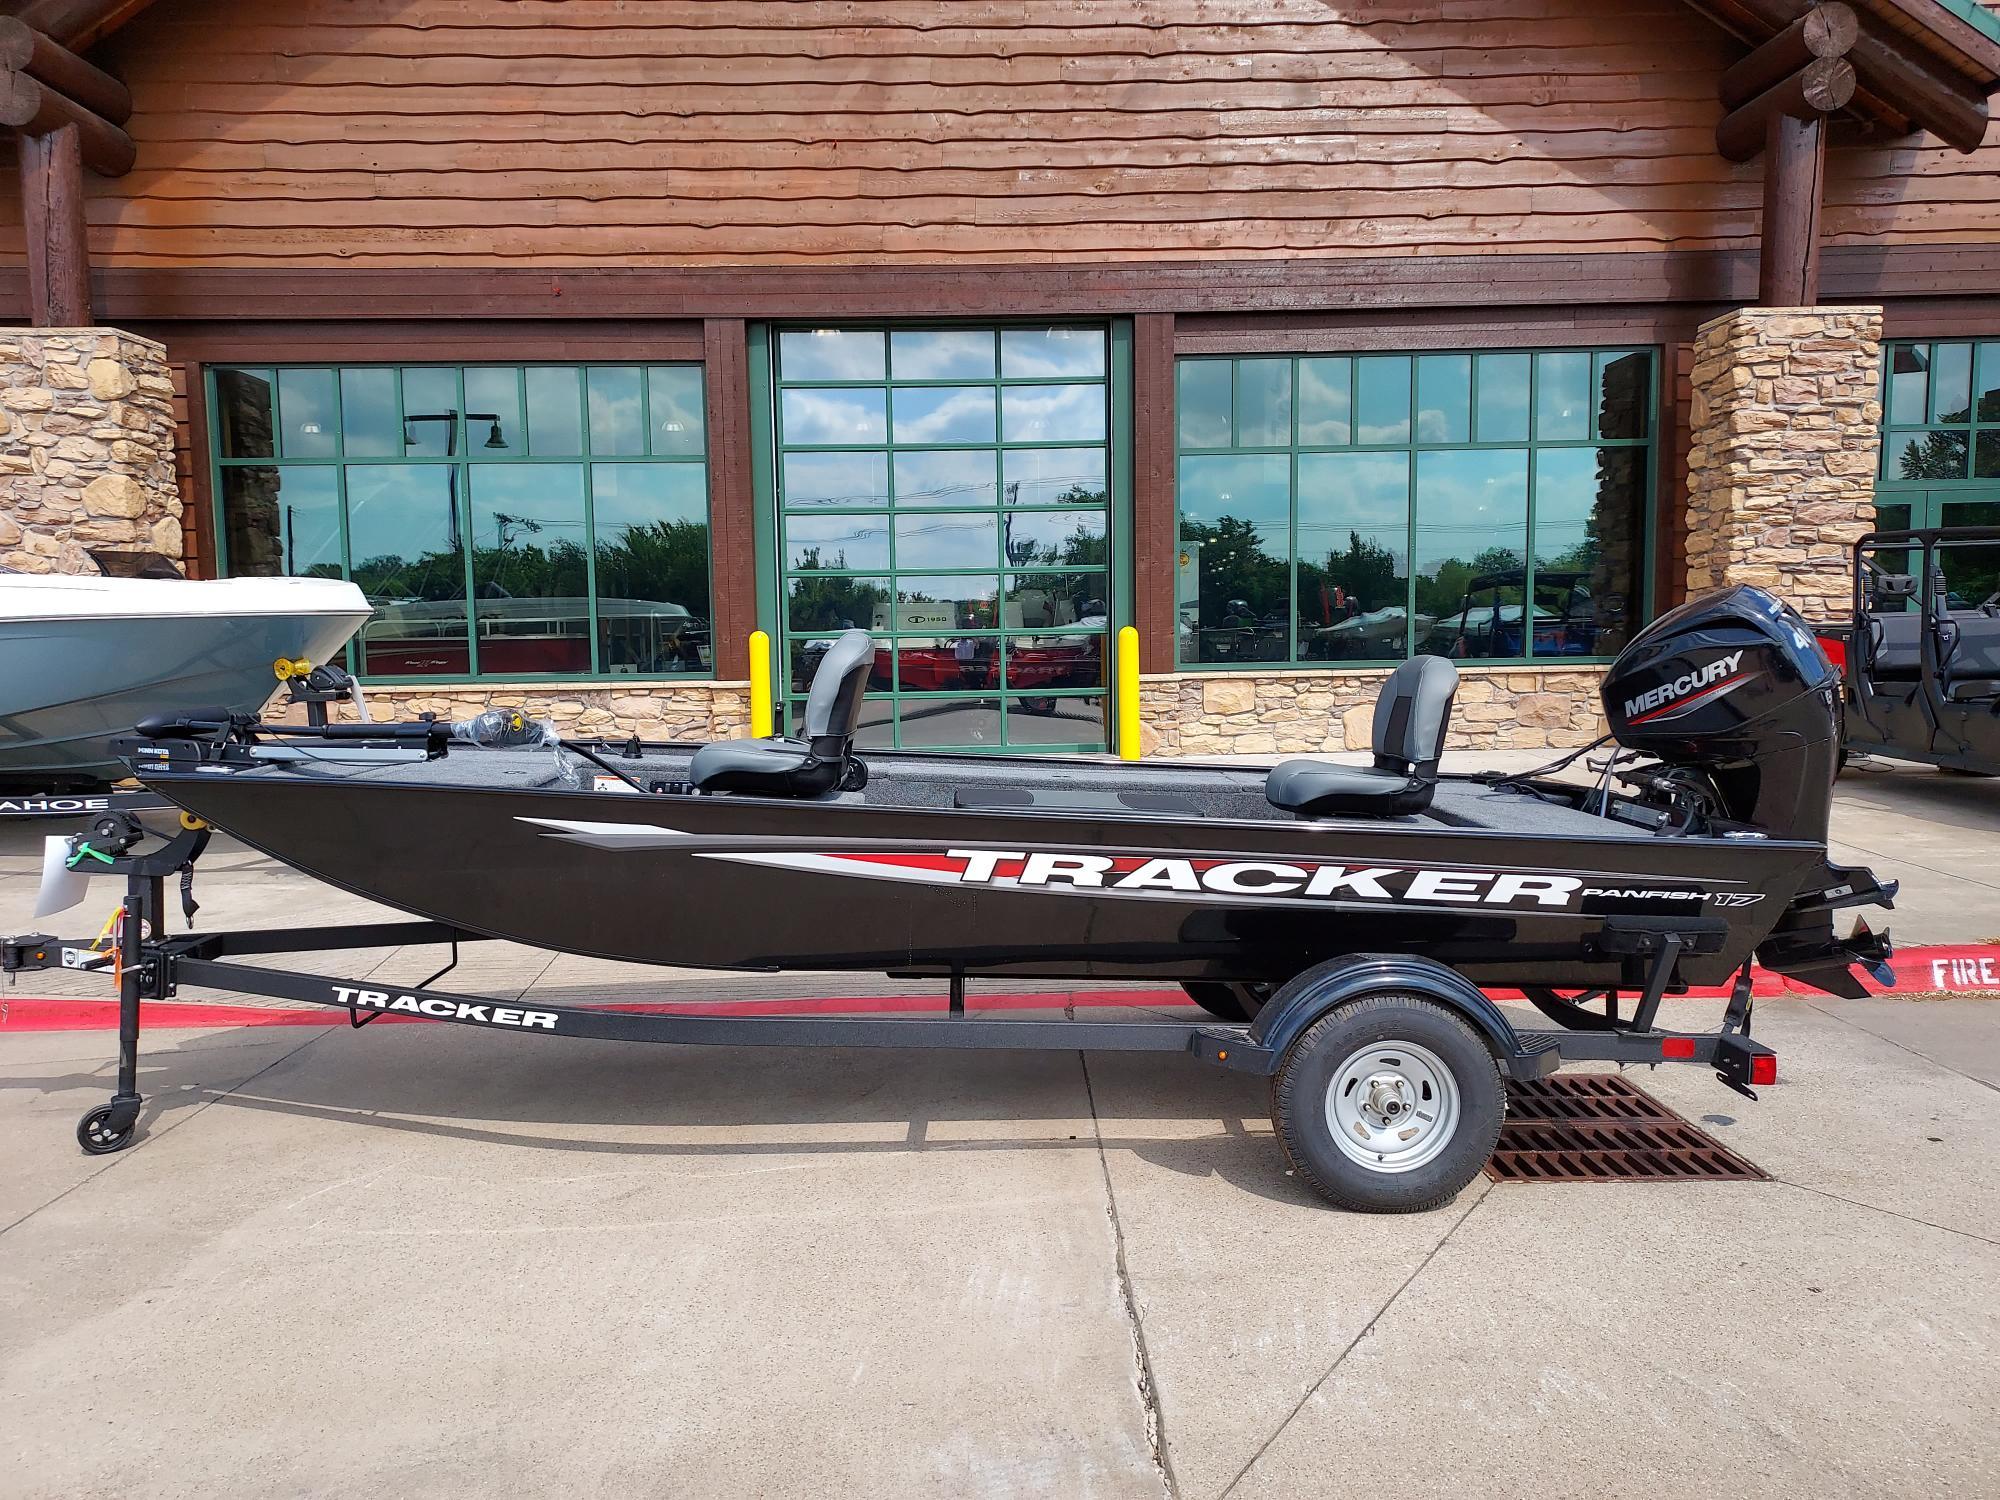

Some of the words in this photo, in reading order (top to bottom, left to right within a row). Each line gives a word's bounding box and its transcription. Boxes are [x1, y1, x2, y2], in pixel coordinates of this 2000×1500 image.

[1625, 650, 1744, 718] MERCURY
[0, 799, 109, 811] AHOE
[945, 849, 1583, 906] TRACKER
[1582, 888, 1712, 901] PANFISH
[1714, 893, 1766, 907] 17
[1931, 957, 2000, 989] FIRE
[332, 986, 559, 1029] TRACKER
